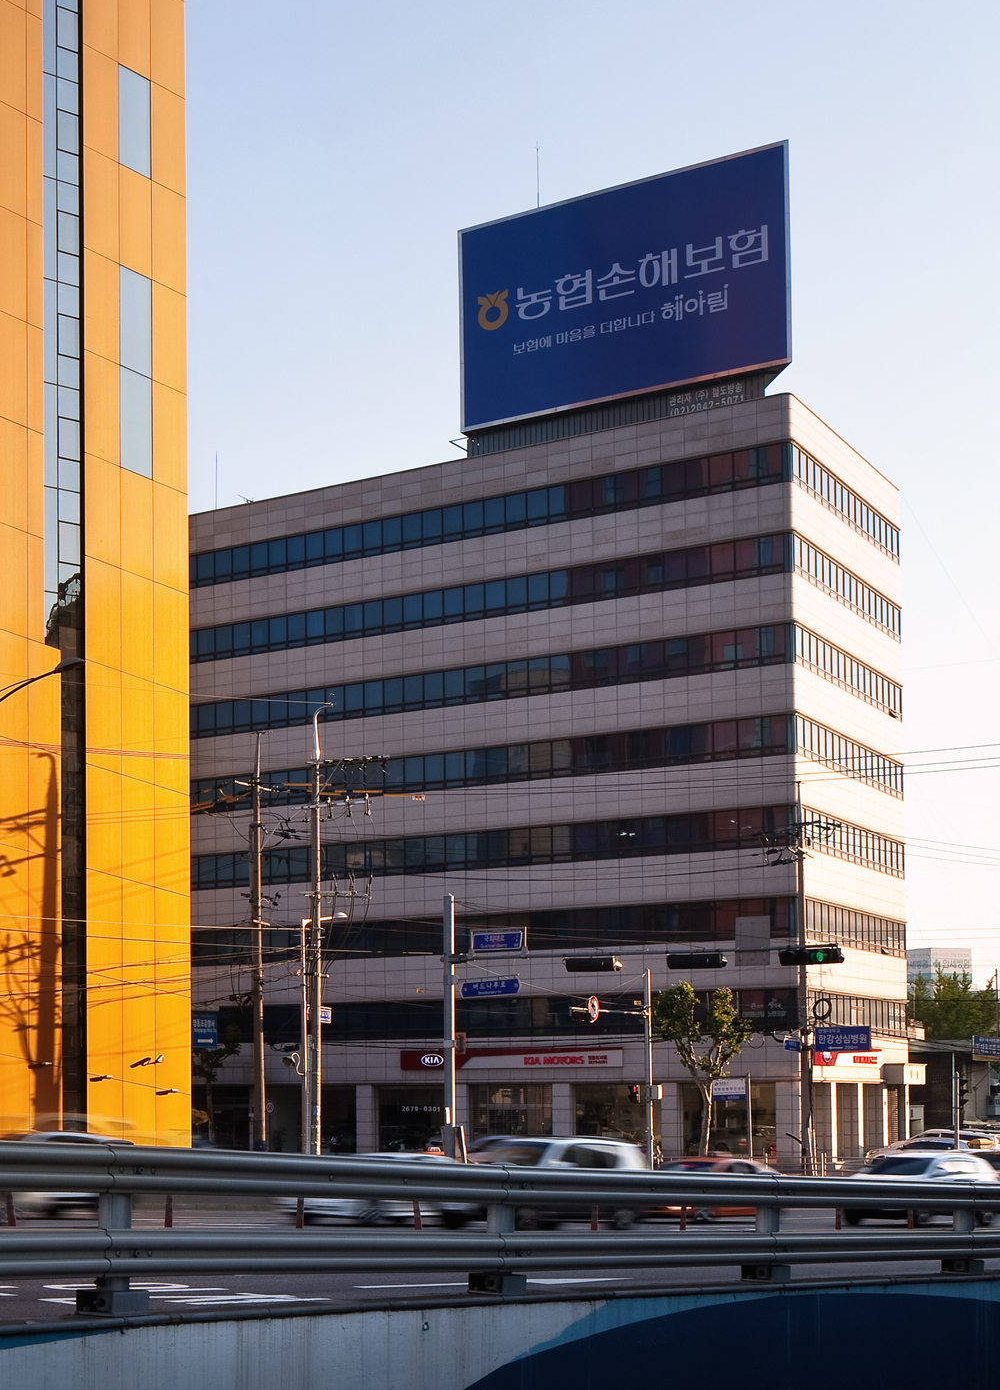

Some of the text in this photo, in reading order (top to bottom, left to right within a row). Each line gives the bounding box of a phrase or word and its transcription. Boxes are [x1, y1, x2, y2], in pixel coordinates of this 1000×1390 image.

[515, 224, 769, 321] 농협손해보험
[513, 283, 729, 356] 보험에 마음을 더합니다 헤아림
[695, 389, 709, 402] (주)
[818, 1033, 867, 1045] 한강성심병원
[423, 1056, 440, 1065] KIA
[523, 1055, 585, 1066] KIA MOTORS
